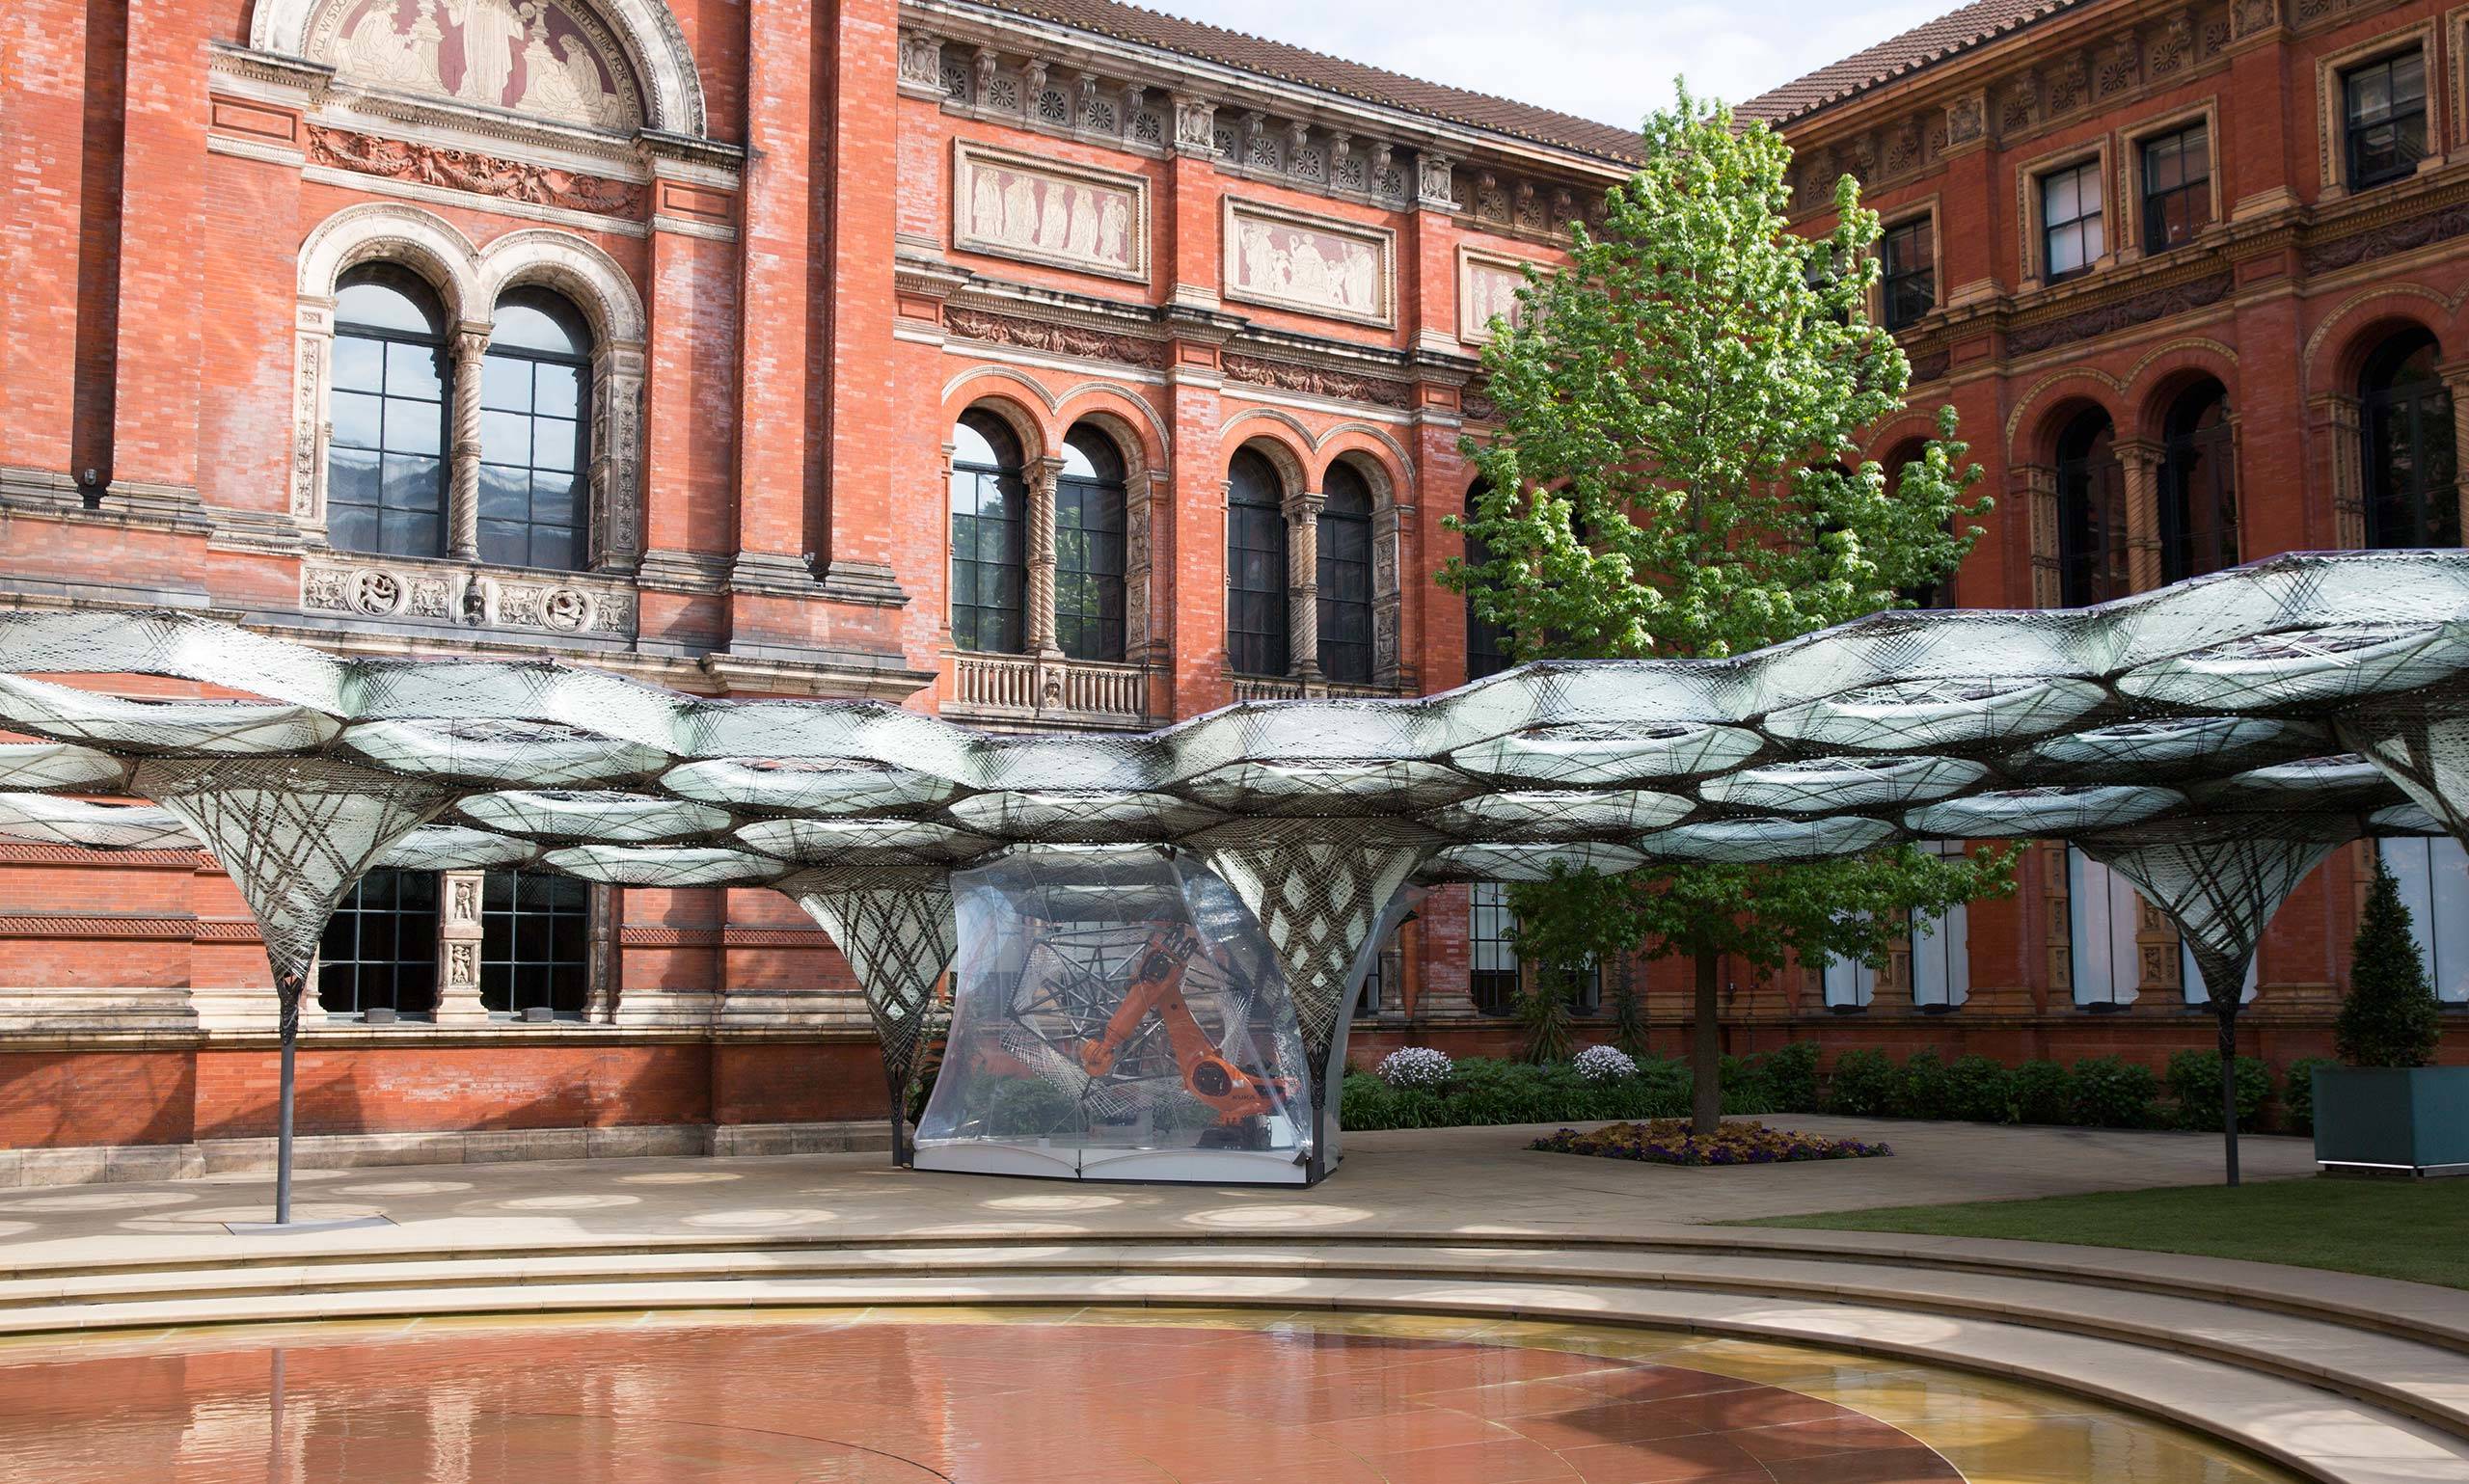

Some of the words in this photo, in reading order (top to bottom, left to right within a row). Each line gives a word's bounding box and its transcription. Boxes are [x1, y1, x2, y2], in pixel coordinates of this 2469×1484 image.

[312, 38, 327, 59] ALL
[570, 0, 596, 31] WITH
[595, 31, 614, 54] HIM
[611, 57, 628, 81] FOR
